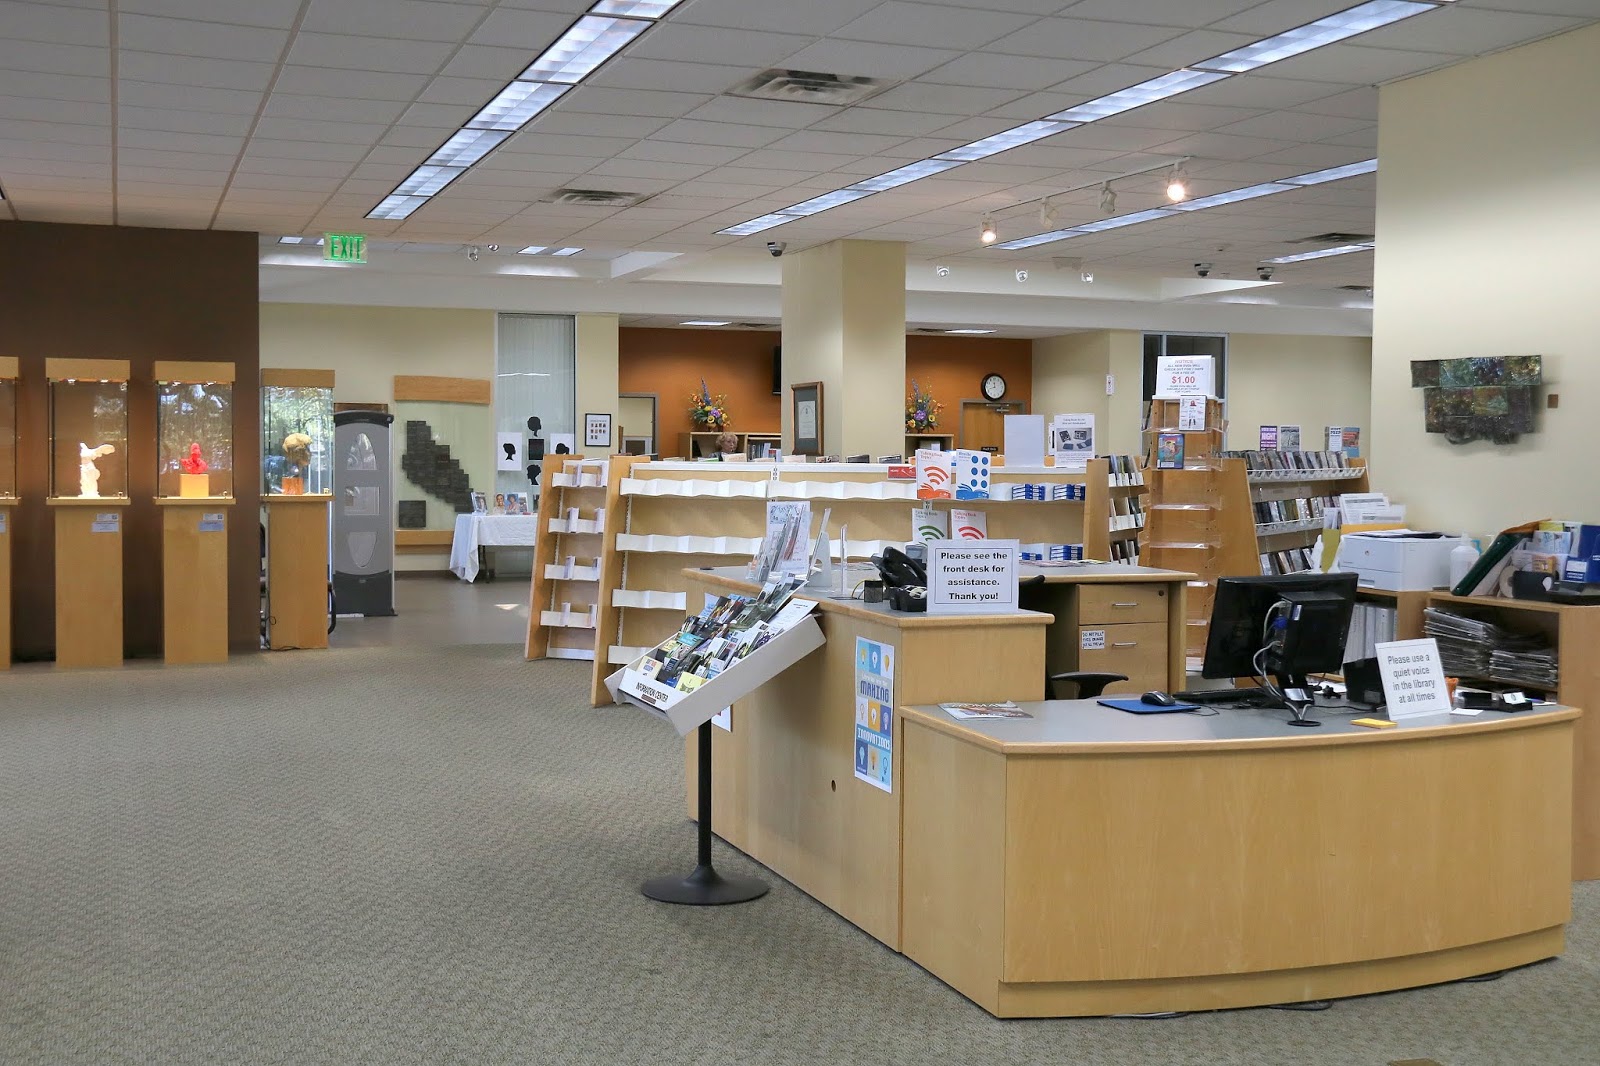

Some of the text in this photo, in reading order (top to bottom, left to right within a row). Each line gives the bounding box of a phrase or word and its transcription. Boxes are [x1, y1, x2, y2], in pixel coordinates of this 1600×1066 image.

[331, 235, 364, 260] EXIT
[1171, 376, 1195, 384] $1.00
[941, 552, 971, 560] Please
[992, 552, 1008, 560] the
[943, 565, 1005, 573] front desk for
[947, 578, 1000, 586] assistance.
[948, 592, 999, 602] Thank you!
[1387, 655, 1411, 665] Please
[1412, 654, 1424, 662] use
[1393, 666, 1430, 678] quiet voice
[1393, 679, 1435, 691] in the library
[860, 680, 890, 703] MAKING
[1398, 692, 1436, 704] at all times
